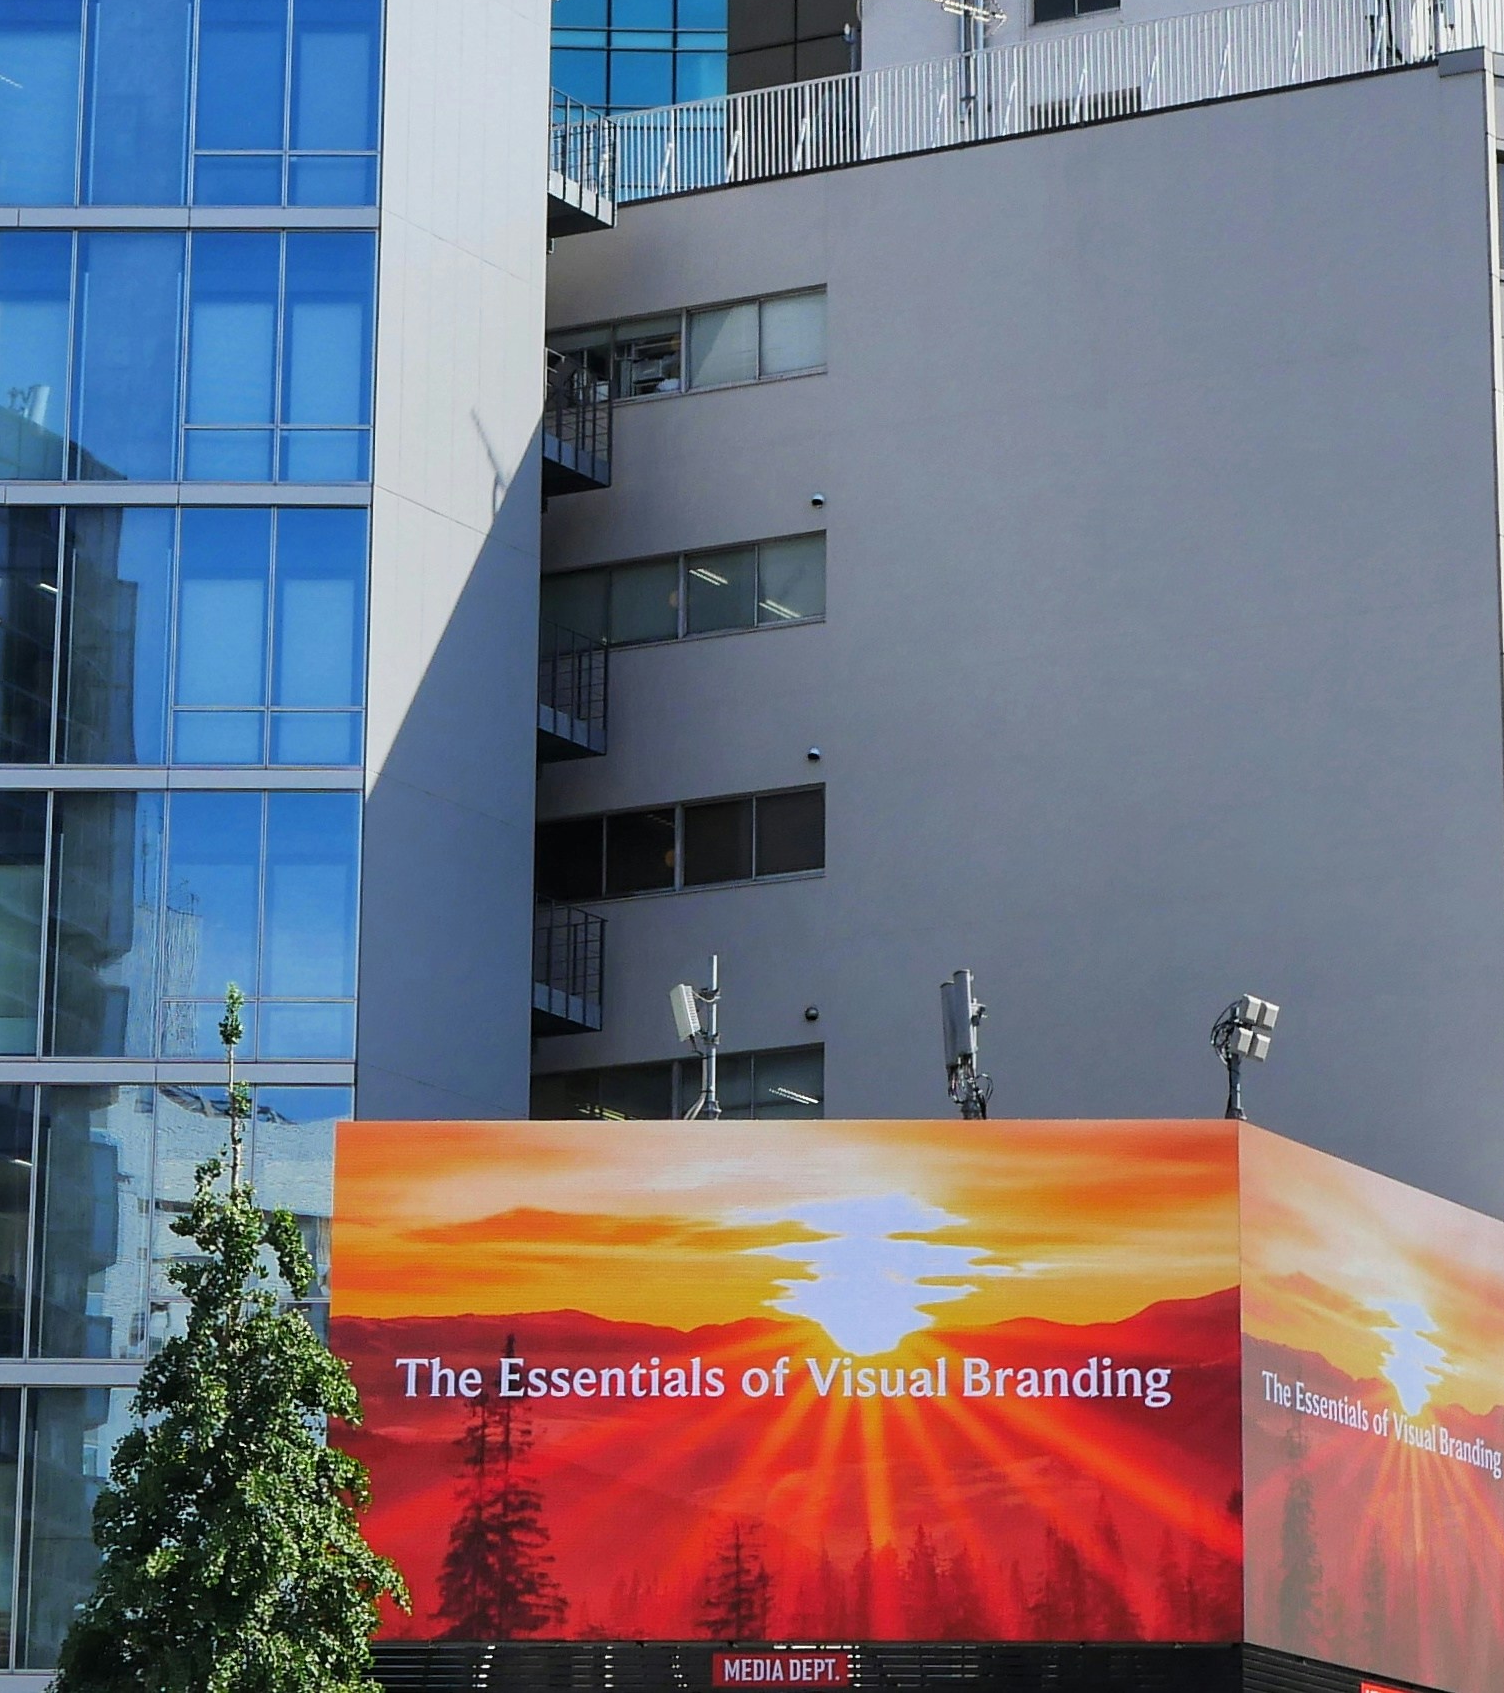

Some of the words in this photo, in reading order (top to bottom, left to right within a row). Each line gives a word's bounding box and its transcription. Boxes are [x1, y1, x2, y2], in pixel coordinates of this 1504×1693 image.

[395, 1356, 483, 1398] The
[499, 1357, 725, 1398] Essentials
[741, 1357, 790, 1398] of
[806, 1357, 946, 1398] Visual
[962, 1357, 1172, 1408] Branding
[1262, 1370, 1291, 1408] The
[1296, 1382, 1368, 1431] Essentials
[1373, 1407, 1389, 1436] of
[1393, 1411, 1436, 1452] Visual
[1440, 1427, 1502, 1479] Branding
[724, 1659, 784, 1681] MEDIA
[789, 1659, 840, 1681] DEPT.
